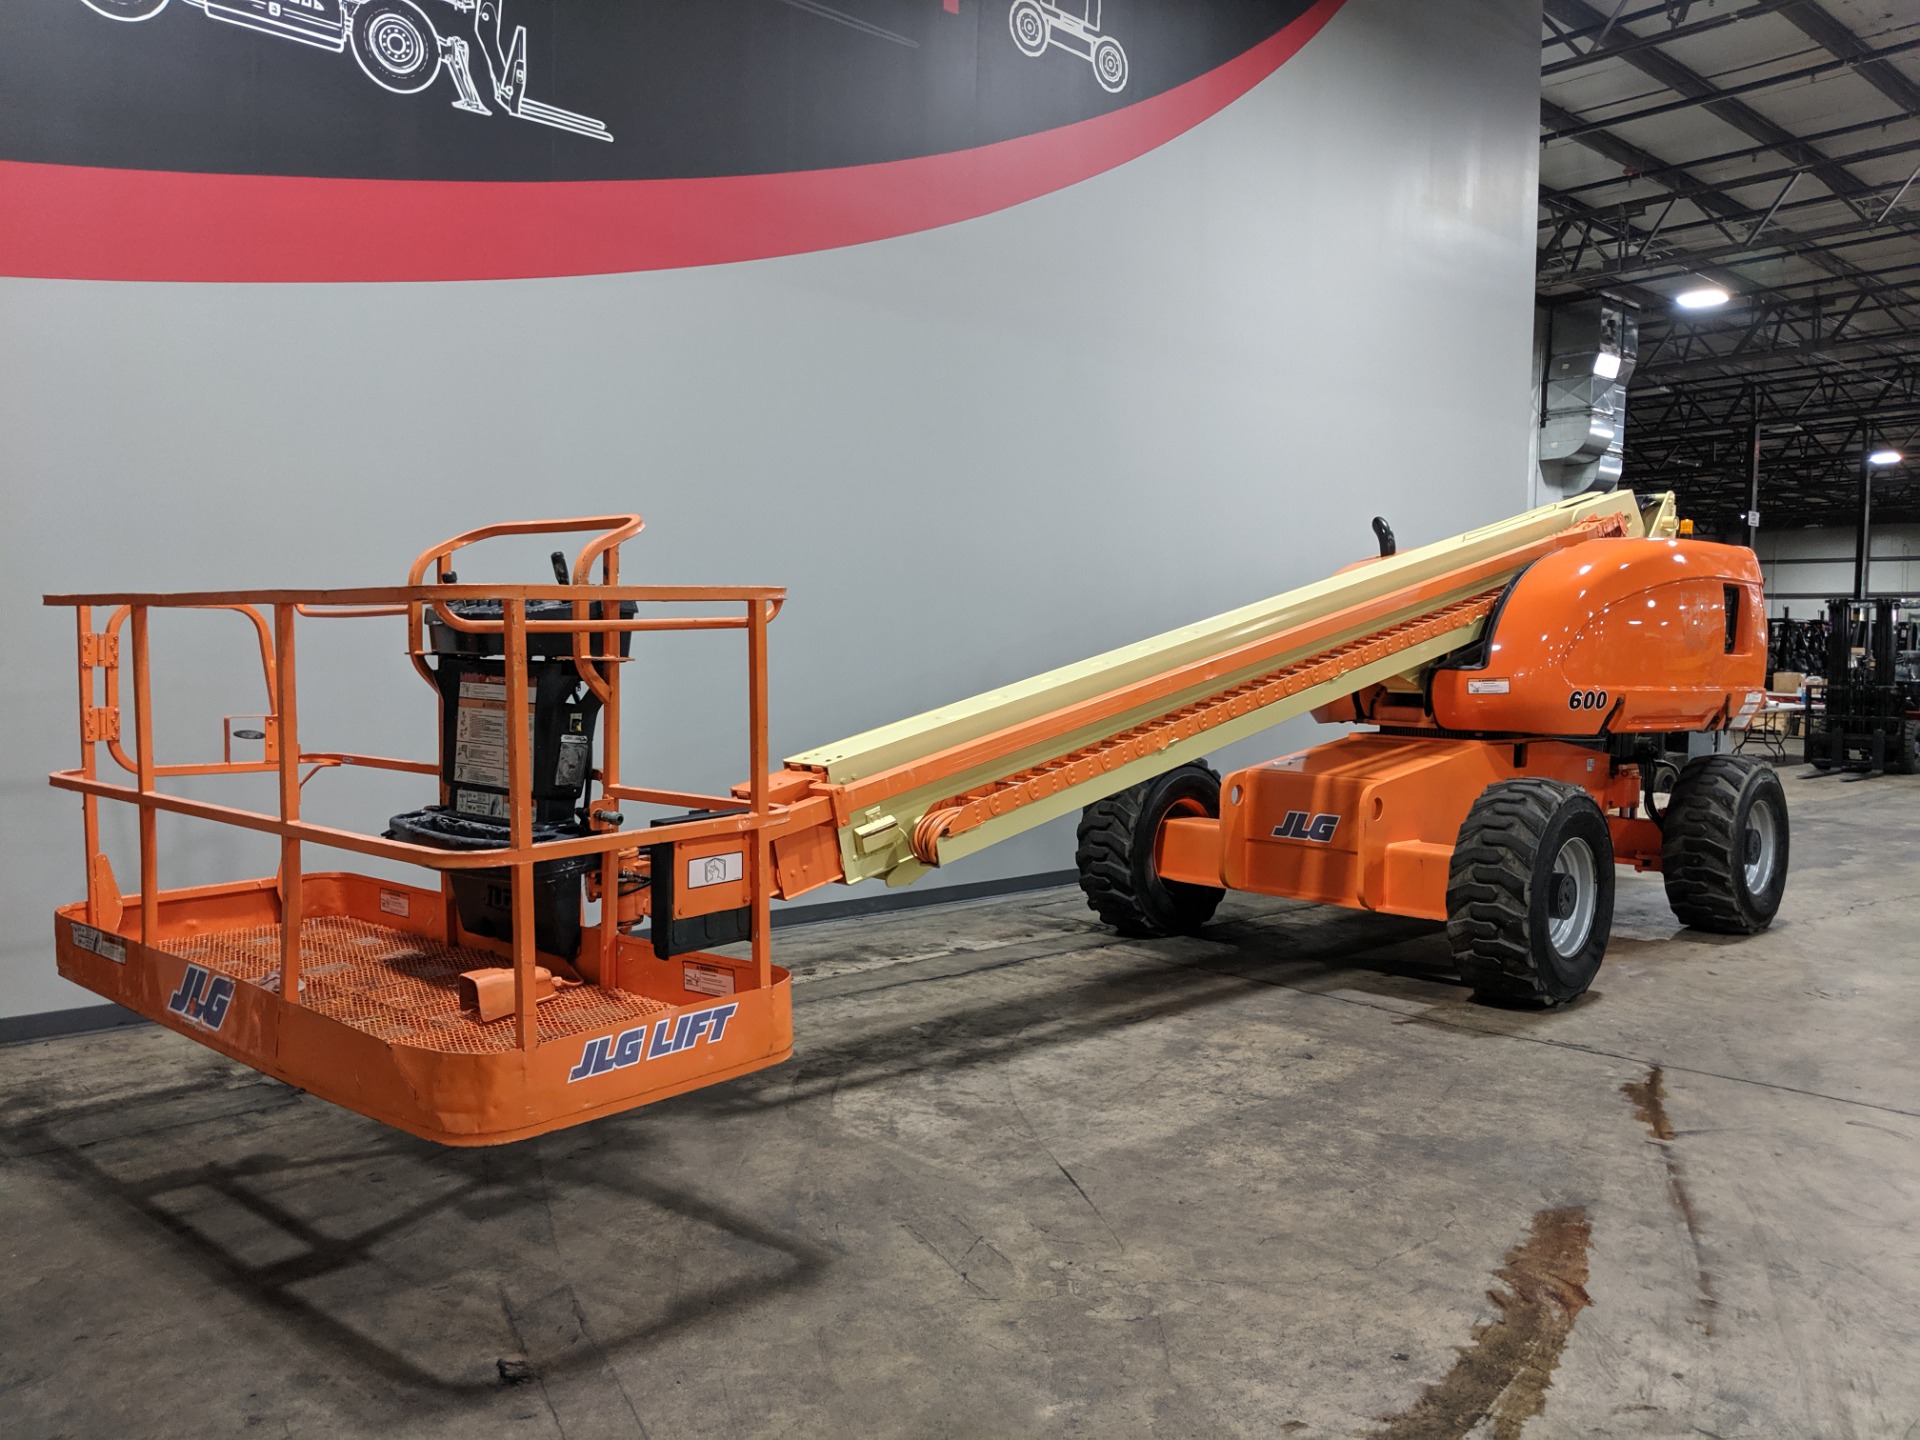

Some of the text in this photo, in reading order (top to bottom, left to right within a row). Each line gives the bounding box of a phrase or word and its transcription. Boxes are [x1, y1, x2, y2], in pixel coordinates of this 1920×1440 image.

[1568, 690, 1608, 711] 600
[1272, 811, 1341, 842] JLG
[168, 964, 235, 1032] JLG
[568, 1003, 739, 1083] JLG LIFT
